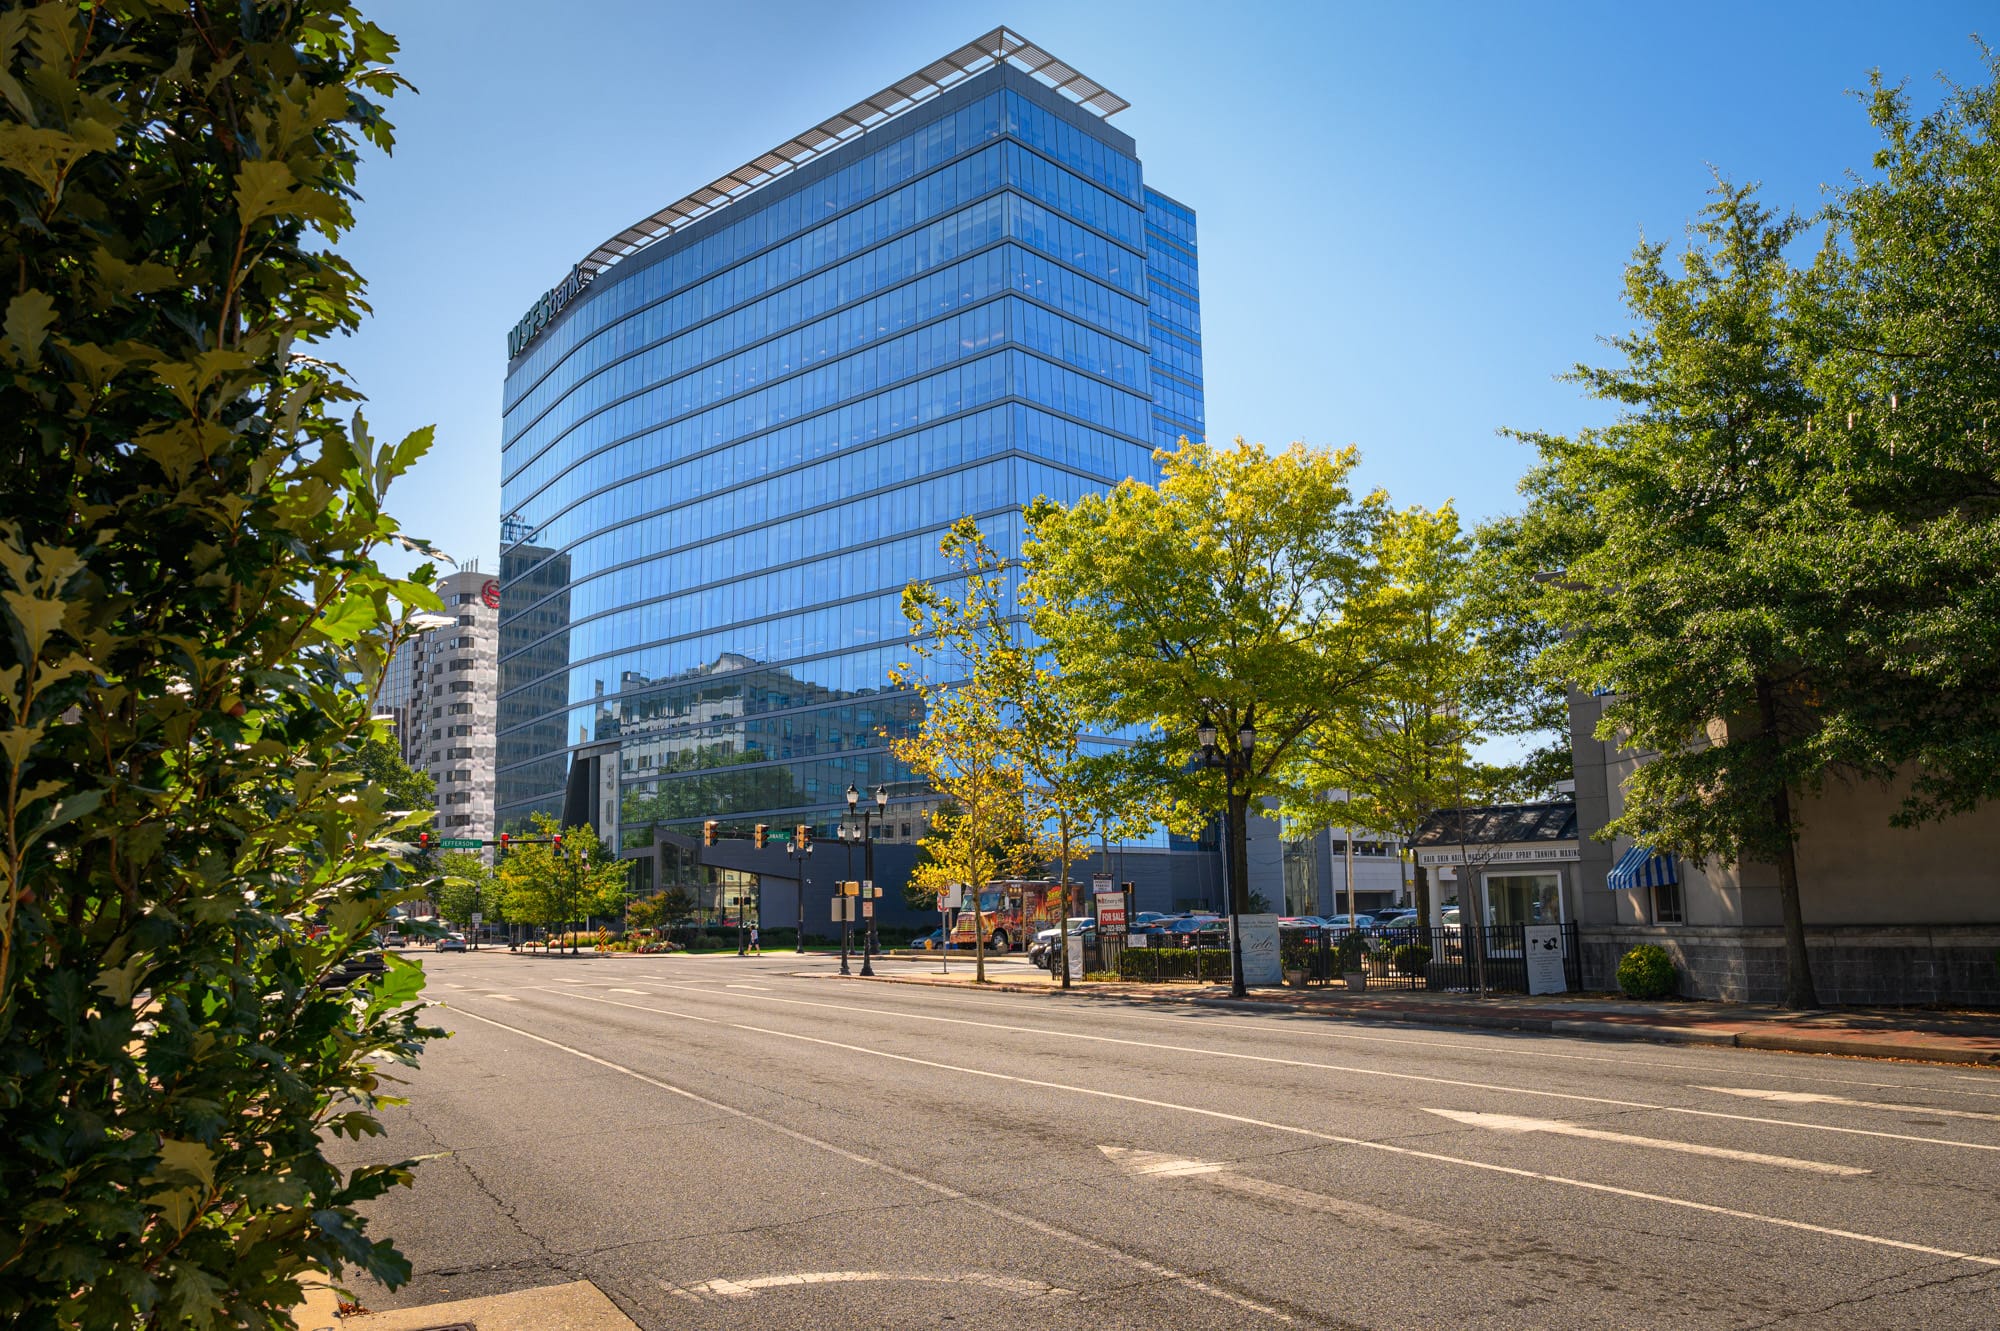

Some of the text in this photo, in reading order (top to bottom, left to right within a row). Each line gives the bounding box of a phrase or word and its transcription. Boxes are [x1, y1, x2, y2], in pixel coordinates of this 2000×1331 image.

[442, 840, 474, 848] JEFFERSON
[1102, 911, 1125, 921] FOR SALE
